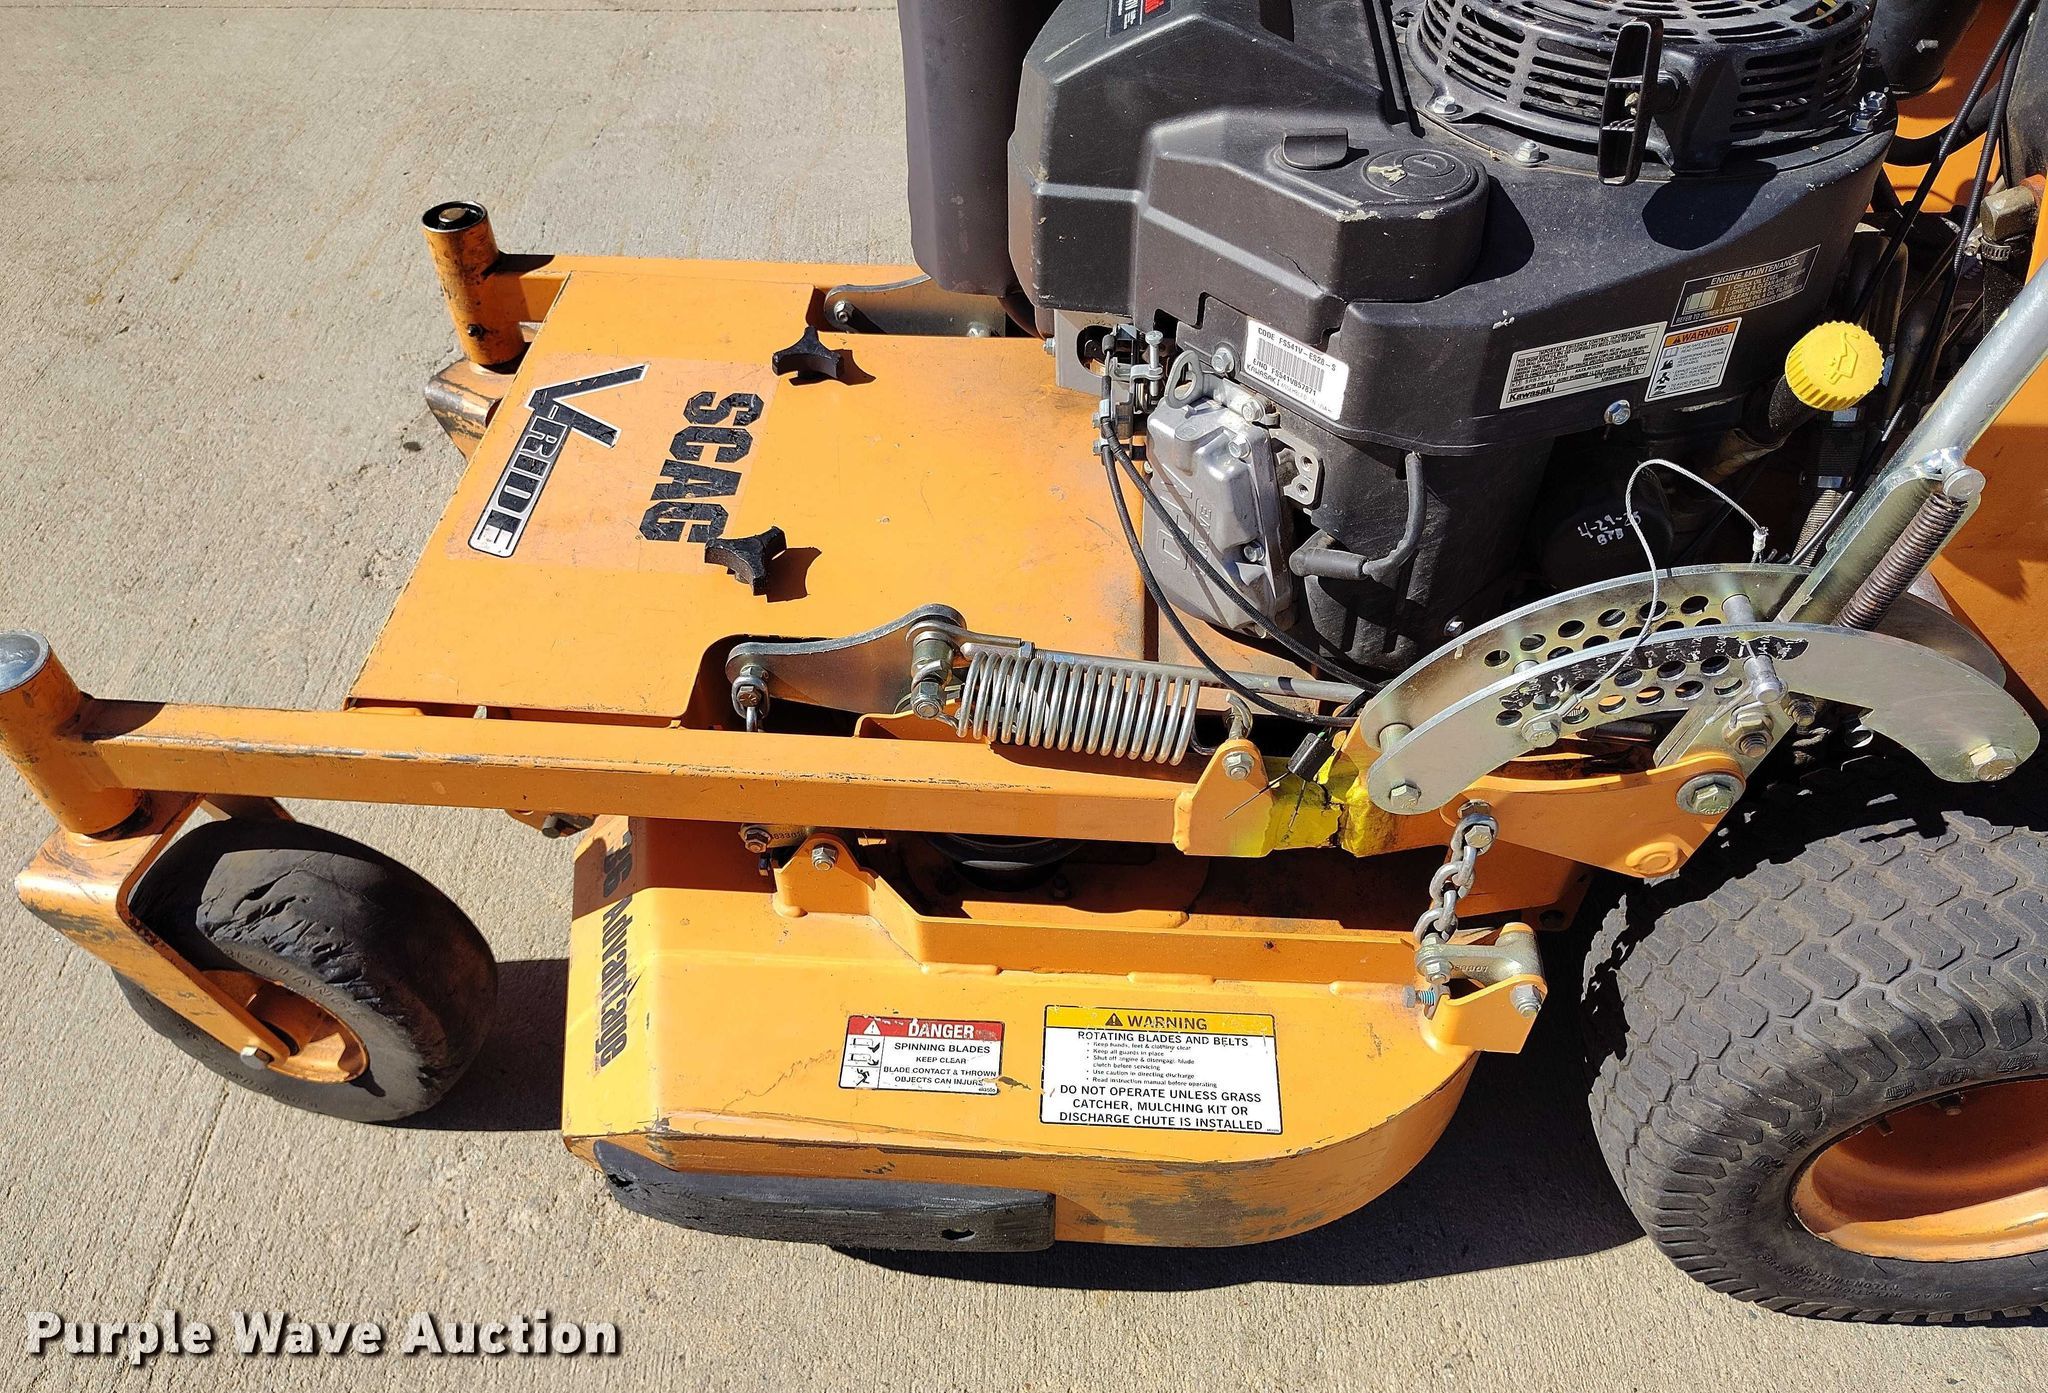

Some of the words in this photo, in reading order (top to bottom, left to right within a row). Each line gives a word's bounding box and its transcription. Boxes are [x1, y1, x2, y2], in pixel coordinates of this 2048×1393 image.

[1711, 272, 1741, 285] ENGINE
[1744, 256, 1799, 279] MAINTENANCE
[1258, 328, 1275, 340] CODE
[1682, 325, 1728, 342] WARNING
[1509, 385, 1556, 400] Kawasaki
[639, 391, 764, 543] SCAG
[596, 894, 632, 1067] Advantage
[908, 1022, 974, 1039] DANGER
[1128, 1015, 1208, 1030] WARNING
[1078, 1032, 1134, 1042] ROTATING
[1138, 1034, 1182, 1044] BLADES
[1186, 1036, 1210, 1045] AND
[1214, 1037, 1248, 1046] BELTS
[894, 1042, 946, 1052] SPINNING
[950, 1045, 990, 1054] BLADES
[1060, 1085, 1077, 1094] DO
[1082, 1086, 1106, 1096] NOT
[1110, 1087, 1165, 1098] OPERATE
[1170, 1090, 1217, 1100] UNLESS
[1222, 1092, 1262, 1102] GRASS
[1073, 1099, 1132, 1111] CATCHER,
[1138, 1102, 1202, 1114] MULCHING
[1208, 1105, 1227, 1115] KIT
[1232, 1106, 1248, 1116] OR
[1060, 1112, 1130, 1124] DISCHARGE
[1134, 1114, 1175, 1126] CHUTE
[1180, 1116, 1191, 1126] IS
[1196, 1118, 1262, 1130] INSTALLED
